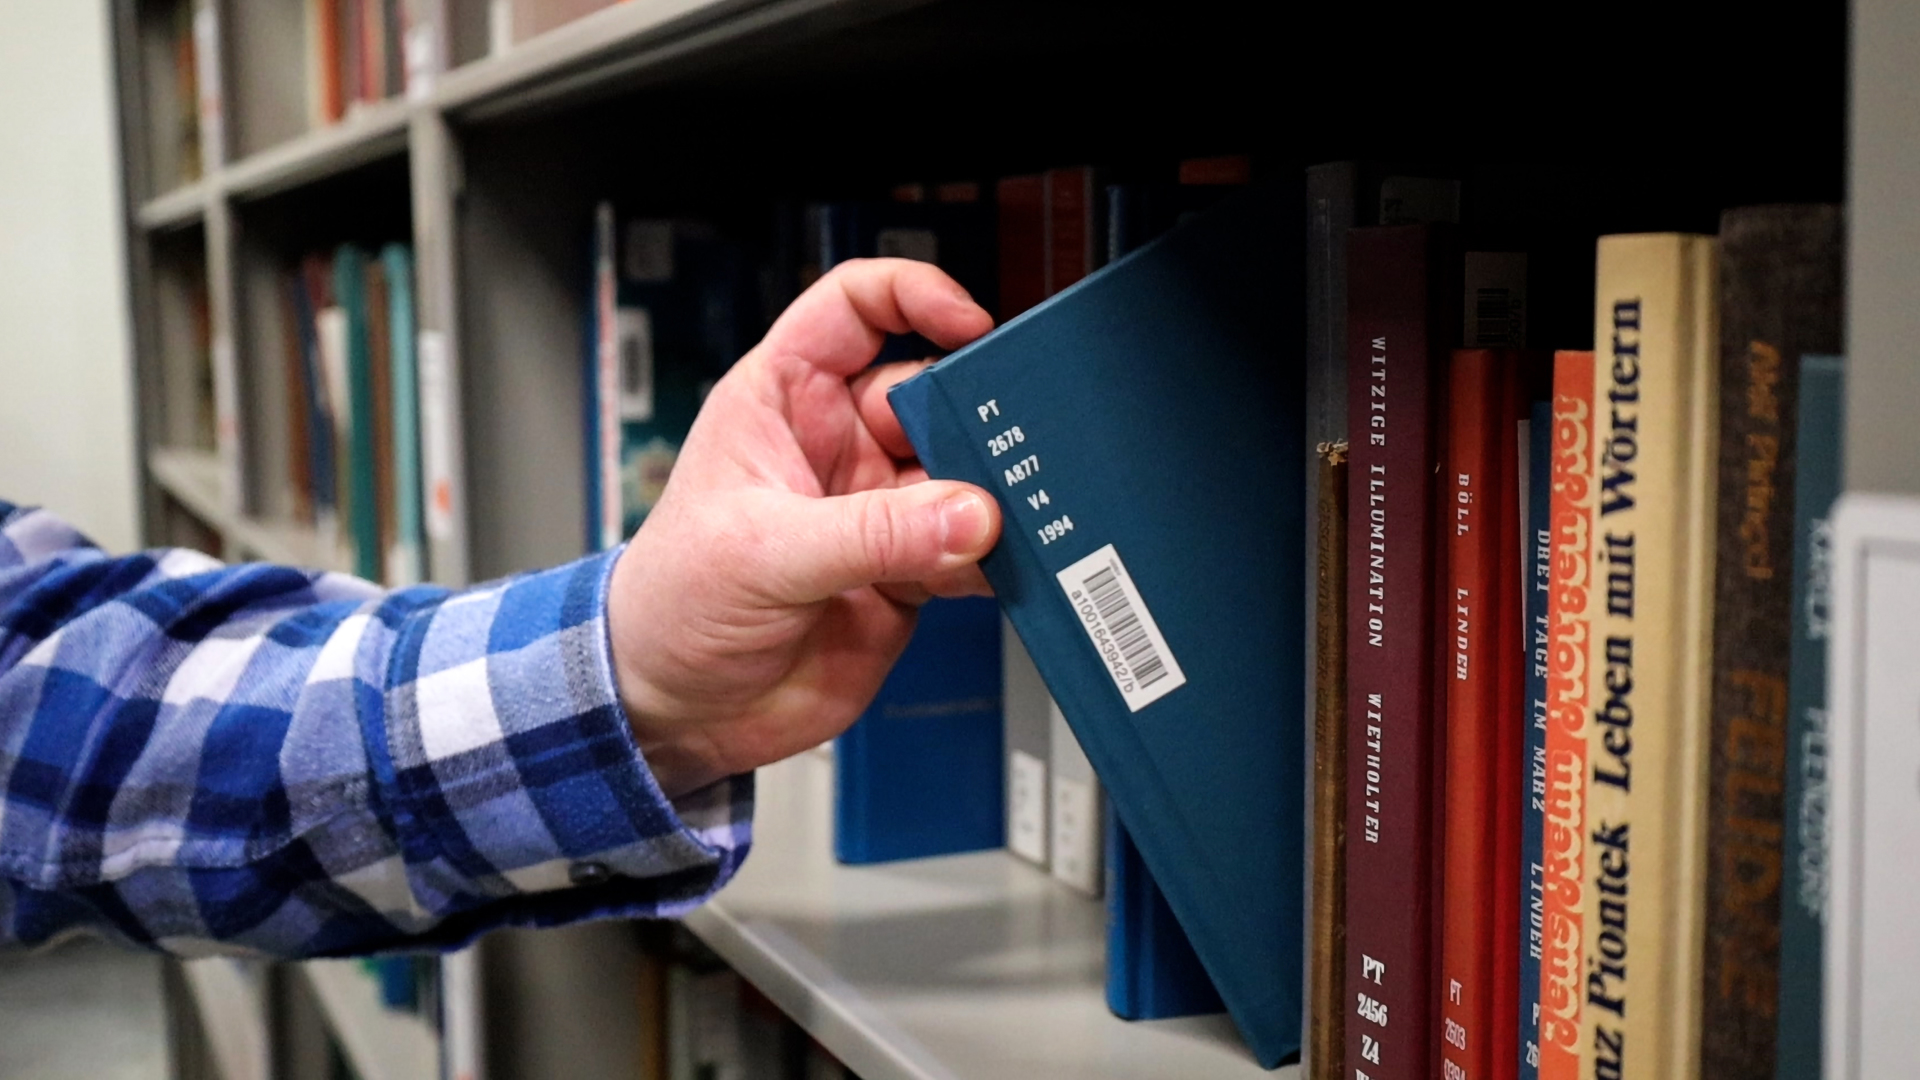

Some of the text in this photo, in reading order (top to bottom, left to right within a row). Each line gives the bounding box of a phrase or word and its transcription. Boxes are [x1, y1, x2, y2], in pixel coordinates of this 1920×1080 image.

[977, 399, 1000, 422] PT
[1600, 297, 1642, 519] Wörtern
[987, 426, 1025, 456] 2678
[1004, 454, 1040, 486] A877
[1037, 514, 1074, 545] 1994
[1536, 529, 1550, 591] DREI
[1364, 336, 1386, 844] WITZIGE ILLUMINATION WIETHOLTER
[1456, 472, 1472, 681] BÖLL LINDER
[1599, 530, 1635, 621] mit
[1071, 589, 1134, 693] a1001643942/b
[1534, 615, 1549, 679] TAGE
[1534, 698, 1547, 731] IM
[1543, 395, 1589, 1055] Jens Rehn Morgen Rot
[1593, 635, 1634, 794] Leben
[1530, 862, 1544, 960] LINDER
[1587, 821, 1630, 1020] Piontek
[1362, 953, 1385, 986] PT
[1449, 978, 1463, 1006] PT
[1356, 992, 1388, 1027] 2456
[1445, 1017, 1466, 1050] 2603
